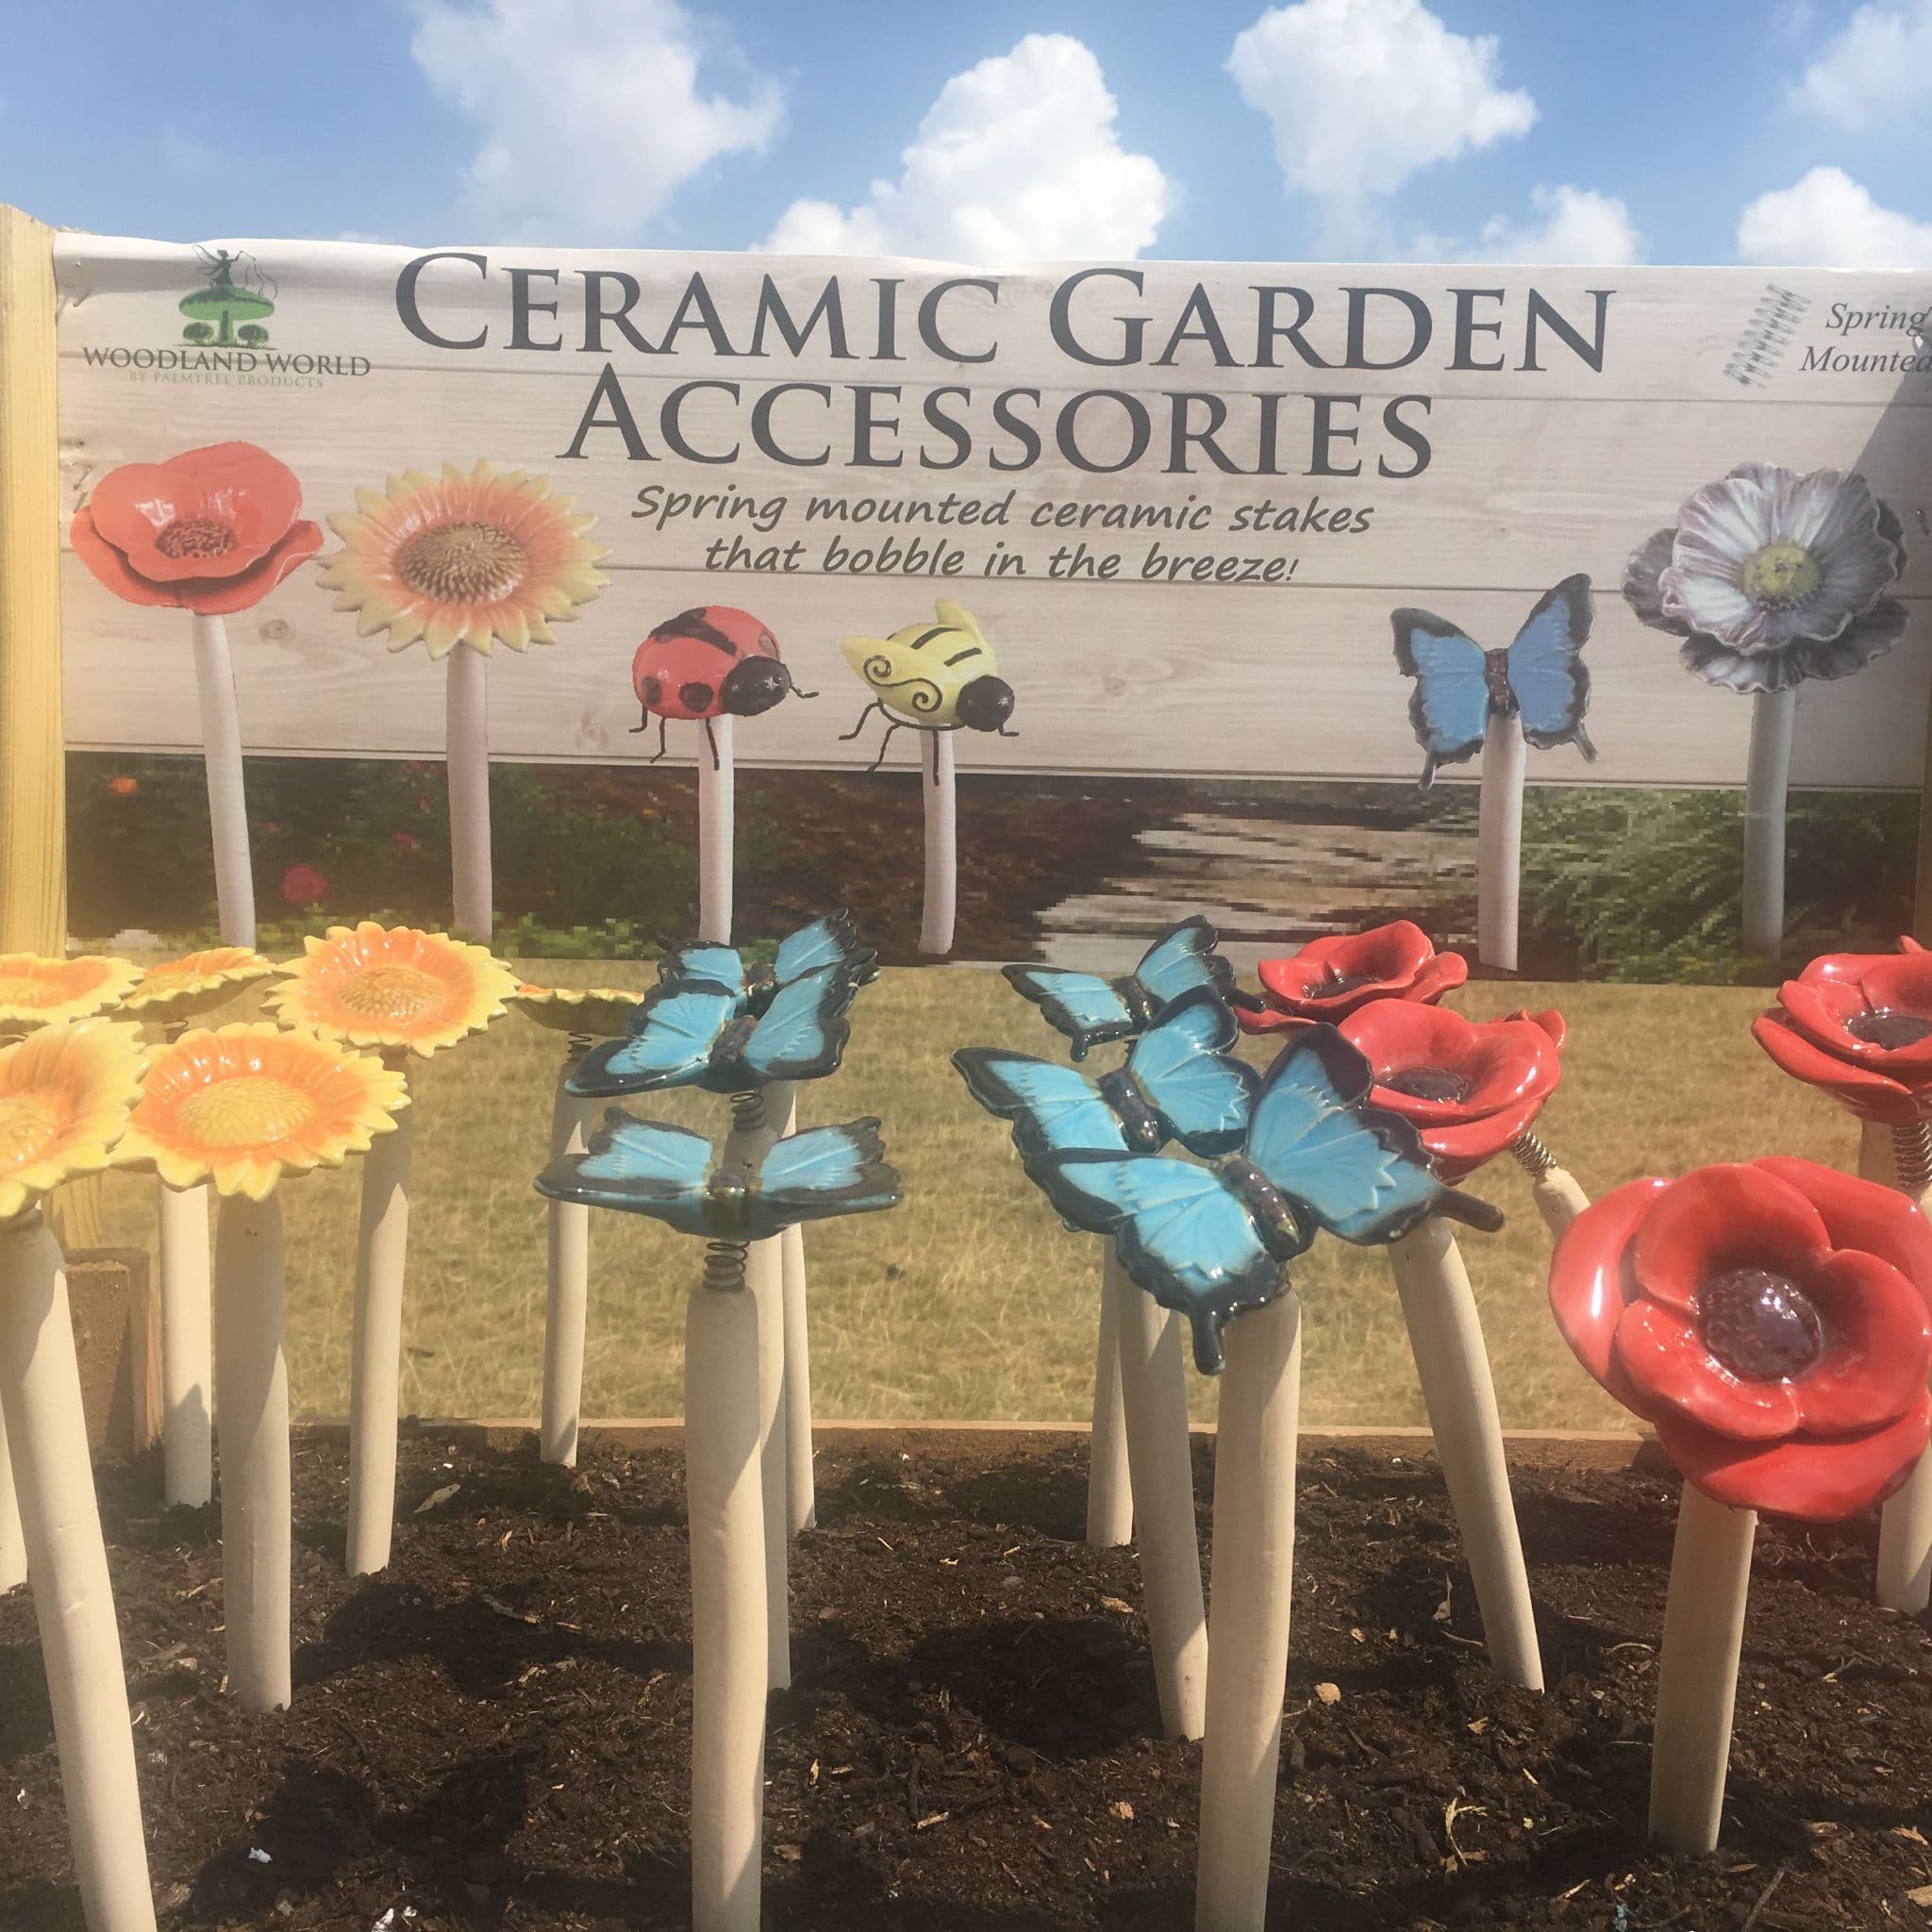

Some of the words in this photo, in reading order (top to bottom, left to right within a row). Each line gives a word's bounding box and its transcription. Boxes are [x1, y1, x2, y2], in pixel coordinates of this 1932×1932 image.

[396, 251, 999, 364] CERAMIC
[1049, 268, 1617, 374] GARDEN
[1825, 302, 1932, 337] Spring
[83, 346, 258, 373] WOODLAND
[265, 354, 372, 376] WORLD
[238, 375, 324, 389] PRODUCTS
[555, 362, 1433, 479] ACCESSORIES
[631, 484, 788, 532] Spring
[806, 489, 1018, 527] mounted
[1030, 493, 1213, 531] ceramic
[1228, 495, 1374, 534] stakes
[706, 535, 807, 572] that
[822, 536, 965, 575] bobble
[985, 541, 1026, 577] in
[1048, 541, 1121, 580] the
[1141, 541, 1299, 583] breeze!
